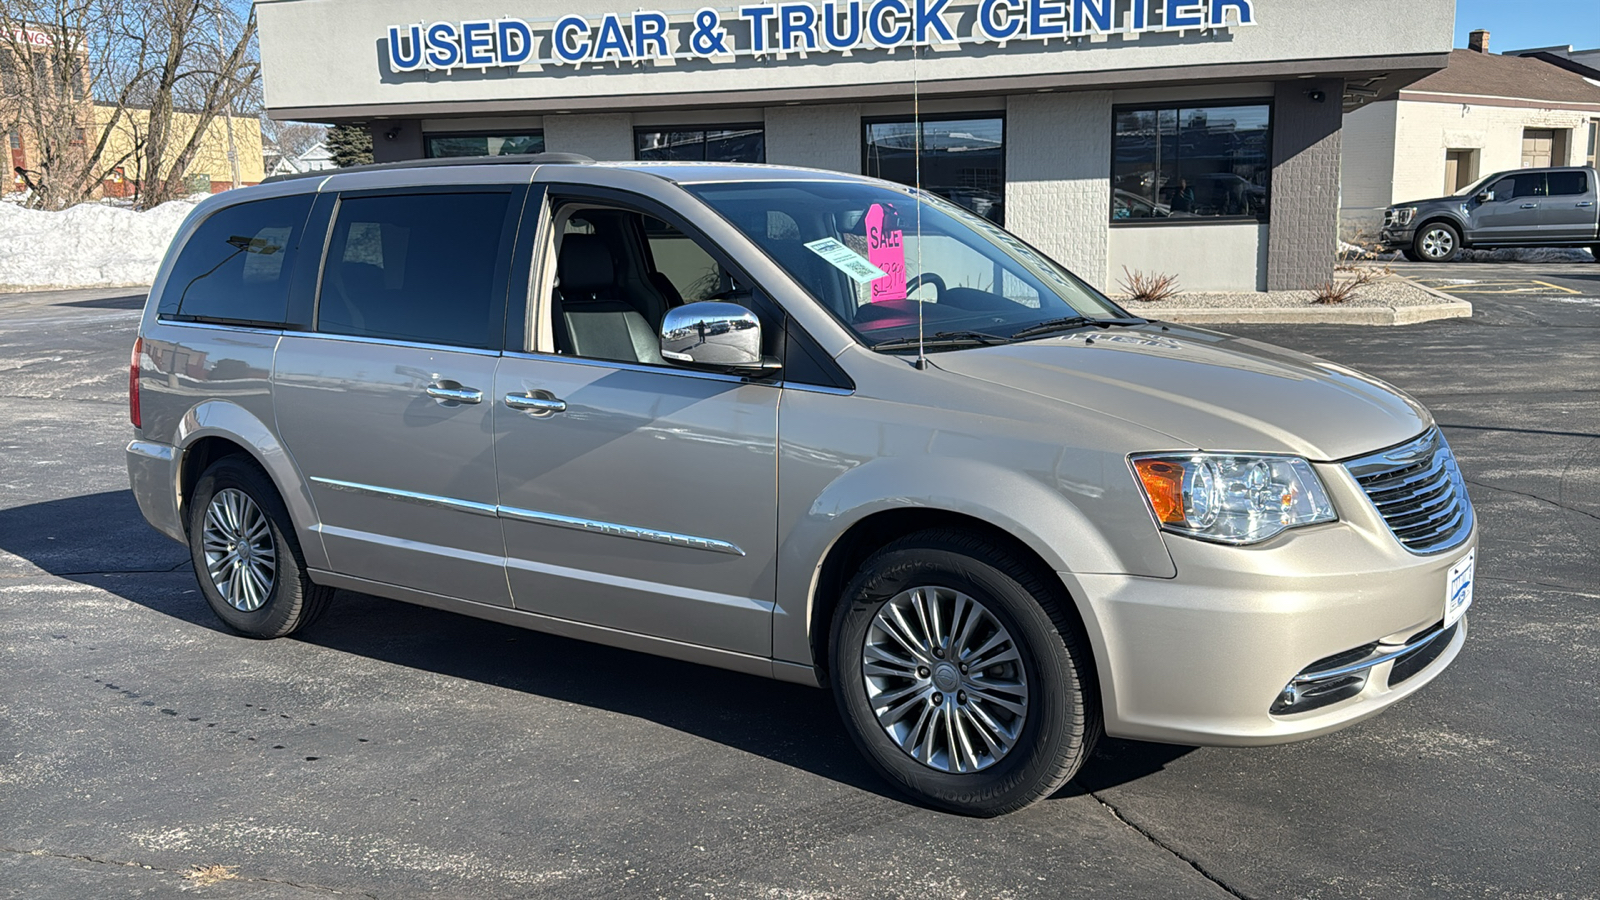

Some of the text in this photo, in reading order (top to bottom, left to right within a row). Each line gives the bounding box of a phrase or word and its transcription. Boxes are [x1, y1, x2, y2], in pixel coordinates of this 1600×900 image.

[389, 0, 1253, 70] USED CAR & TRUCK CENTER
[870, 226, 900, 249] SALE
[584, 521, 716, 549] CHRYSLER
